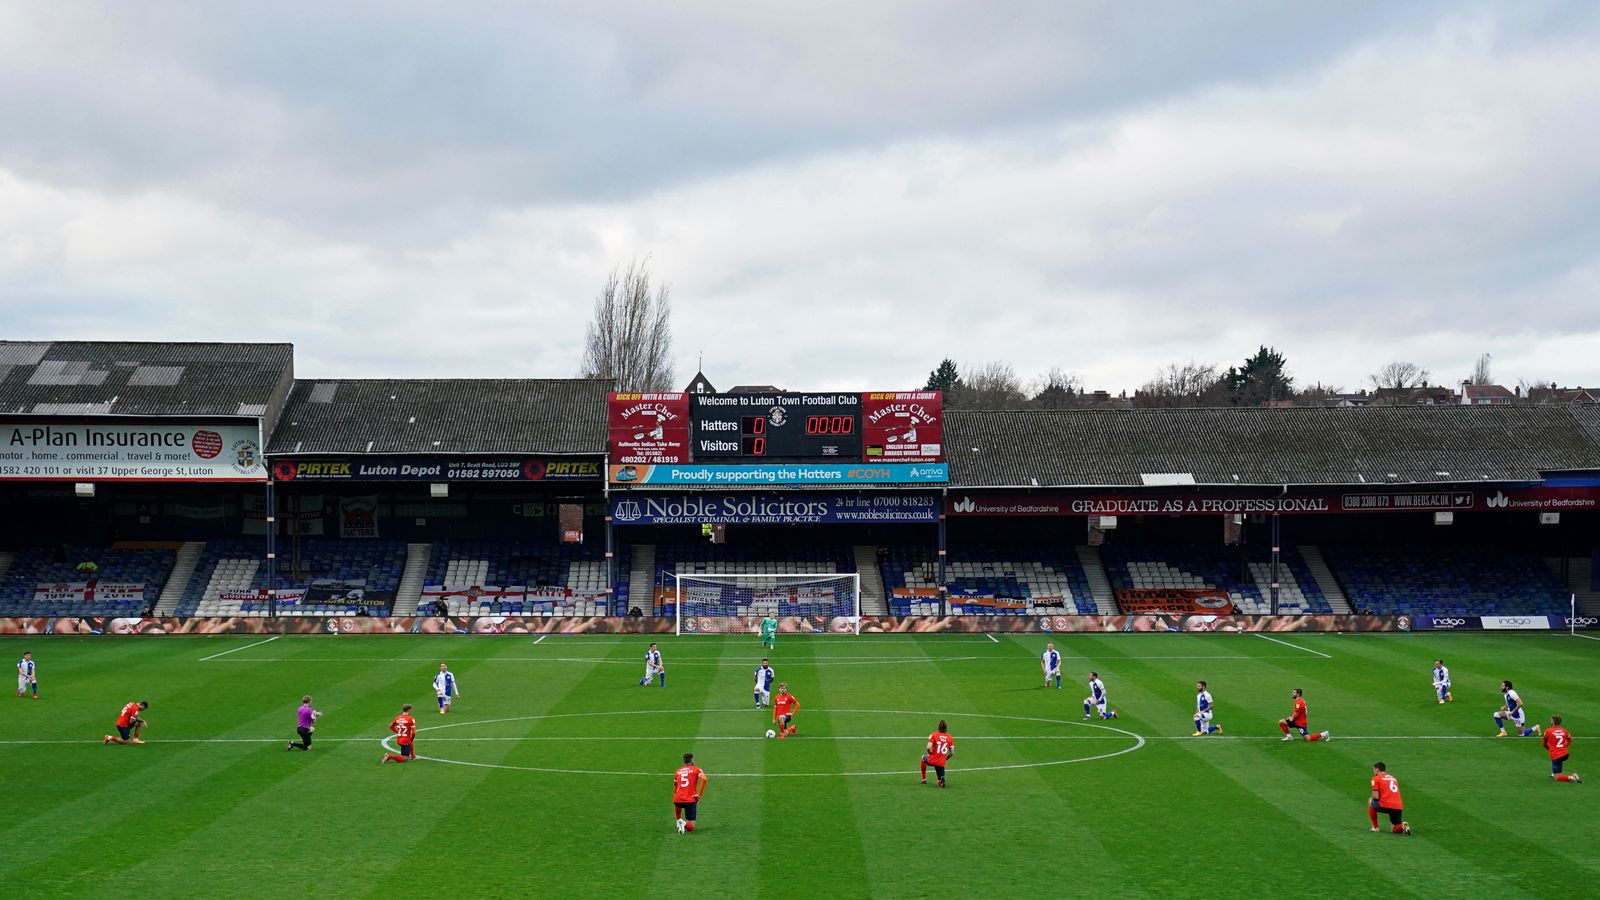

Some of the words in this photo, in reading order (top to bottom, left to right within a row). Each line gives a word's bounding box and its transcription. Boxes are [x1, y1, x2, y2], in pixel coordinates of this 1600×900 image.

[698, 396, 738, 406] Welcome
[740, 396, 748, 406] to
[750, 396, 774, 406] Luton
[776, 396, 800, 405] Town
[802, 396, 836, 405] Football
[838, 396, 857, 405] Club
[621, 403, 652, 420] Master
[655, 403, 678, 420] Chef
[869, 404, 906, 424] Master
[910, 404, 936, 424] Chef
[701, 420, 738, 431] Hatters
[753, 418, 764, 434] 0
[807, 416, 852, 434] 00:00
[10, 427, 77, 446] A-Plan
[86, 428, 185, 446] Insurance
[700, 440, 738, 451] Visitors
[753, 438, 764, 454] 0
[32, 451, 58, 460] home
[66, 451, 119, 460] commercial
[127, 451, 152, 460] travel
[156, 452, 162, 460] &
[164, 452, 191, 460] more!
[23, 466, 40, 474] 420
[44, 466, 59, 474] 101
[76, 466, 95, 475] visit
[111, 467, 139, 476] Upper
[141, 467, 173, 477] George
[189, 467, 213, 475] Luton
[297, 463, 351, 474] PIRTEK
[360, 464, 397, 475] Luton
[400, 464, 440, 477] Depot
[448, 470, 479, 478] 01582
[481, 470, 520, 478] 597050
[545, 462, 599, 473] PIRTEK
[672, 470, 713, 481] Proudly
[716, 470, 775, 481] supporting
[777, 469, 796, 479] the
[798, 469, 842, 479] Hatters
[848, 469, 890, 479] #COYH
[644, 497, 716, 517] Noble
[722, 496, 828, 516] Solicitors
[846, 497, 855, 506] hr
[856, 497, 870, 506] line
[873, 497, 900, 506] 07000
[902, 496, 934, 506] 818283
[1072, 500, 1159, 512] GRADUATE
[1162, 500, 1183, 512] AS
[1186, 500, 1198, 512] A
[1201, 499, 1328, 512] PROFESSIONAL
[1344, 496, 1360, 507] 0300
[1361, 496, 1376, 507] 3300
[1377, 496, 1389, 507] 073
[1394, 495, 1449, 506] WWW.BEDS.AC.UK
[1509, 499, 1541, 508] University
[1542, 498, 1551, 506] of
[1552, 498, 1595, 506] Bedfordshire
[836, 508, 934, 520] www.noblesolicitors.co.uk
[976, 505, 1008, 513] University
[936, 741, 948, 754] 16
[1555, 735, 1564, 748] 2
[680, 774, 689, 787] 5
[1390, 780, 1398, 793] 6
